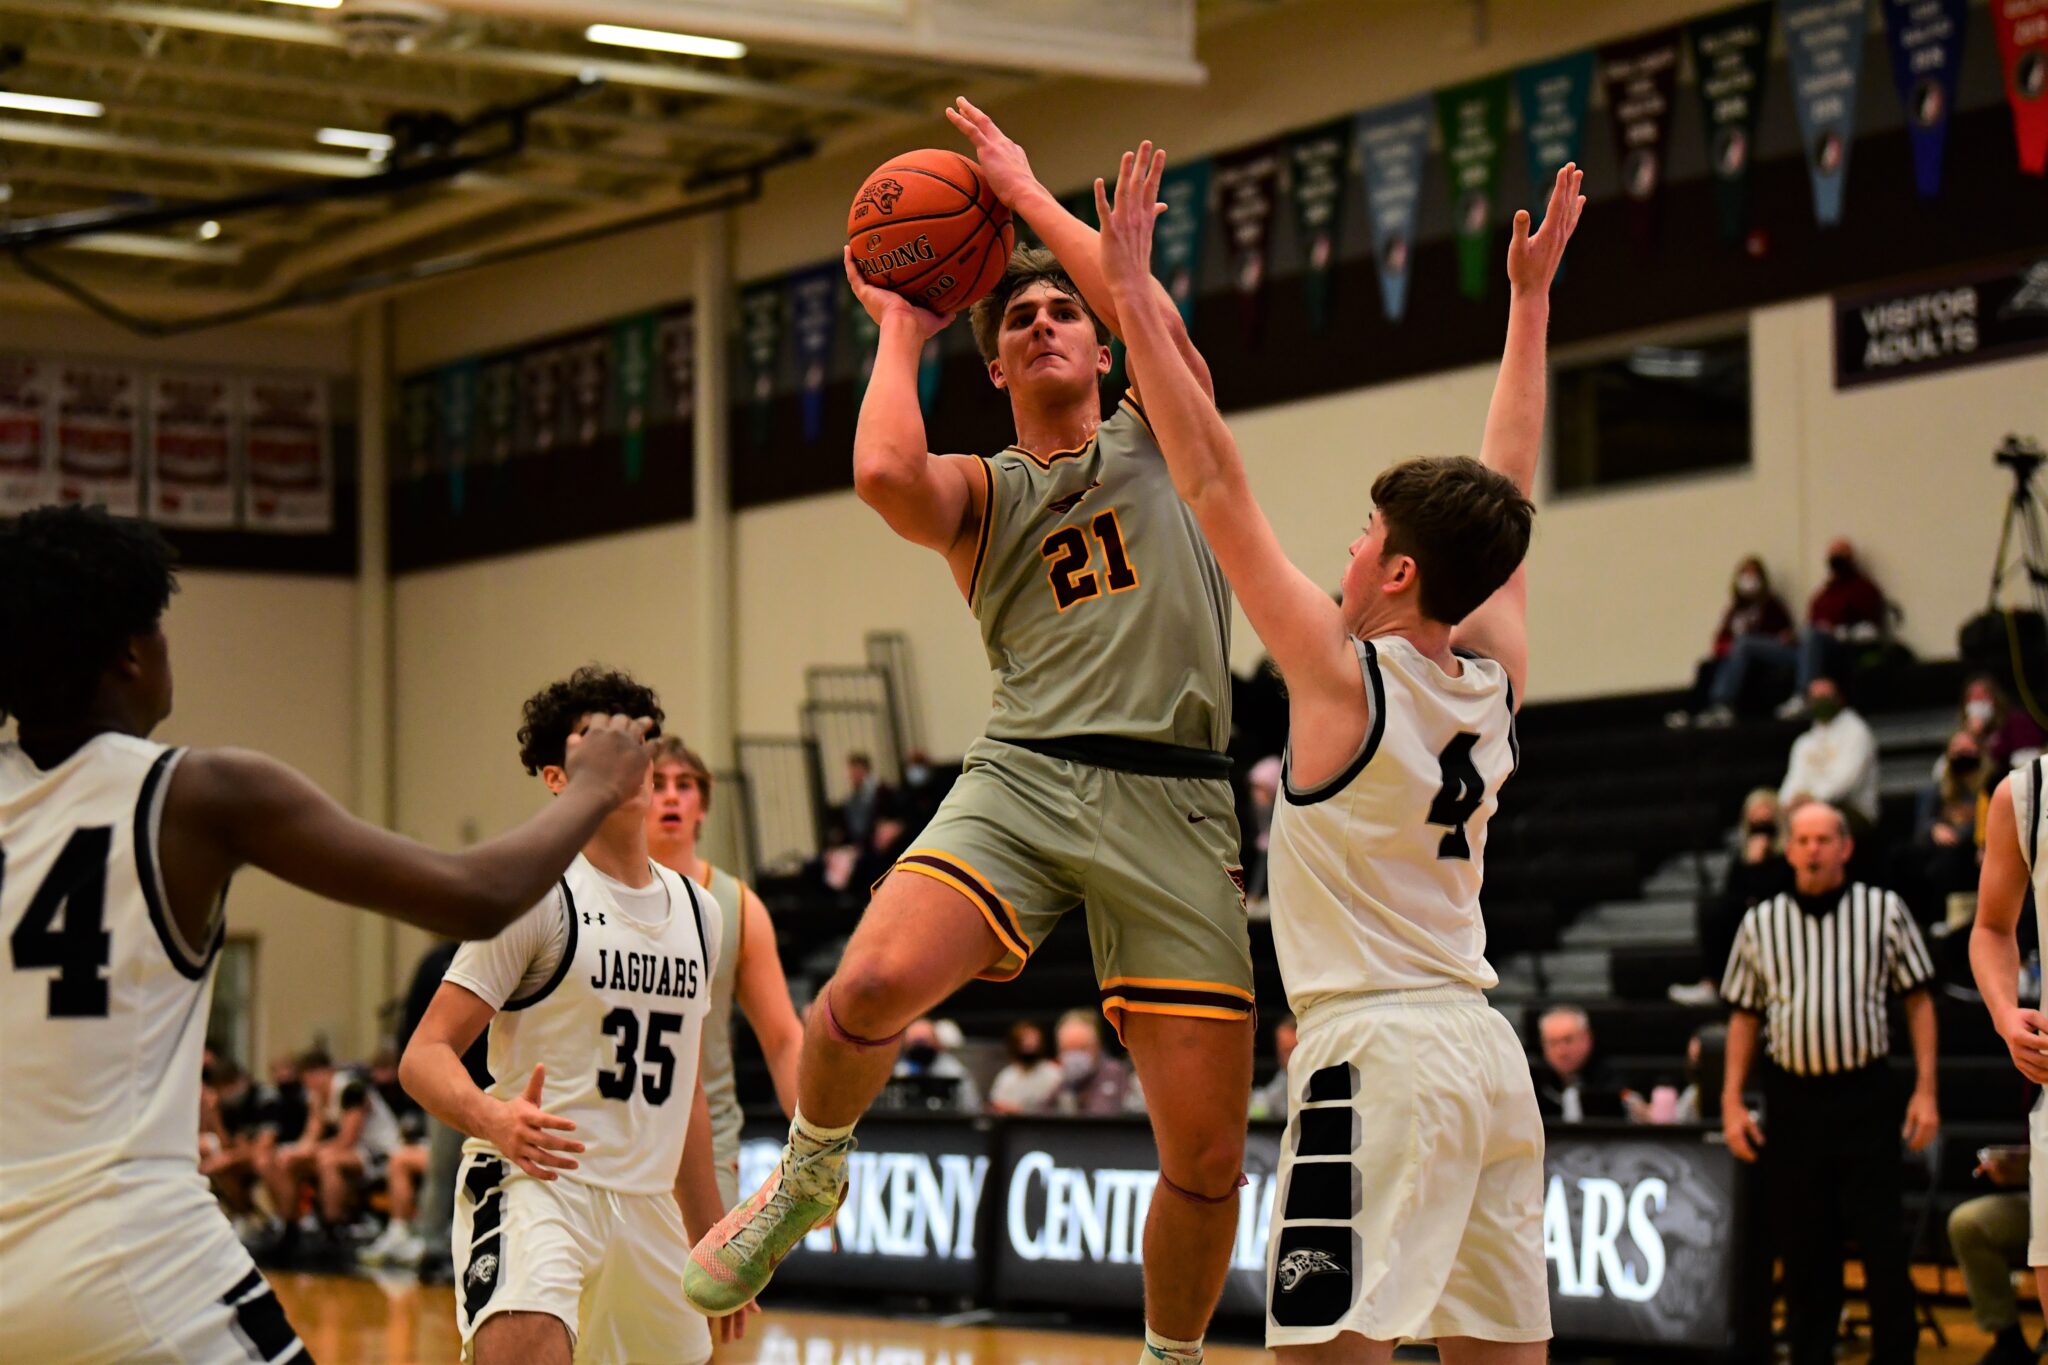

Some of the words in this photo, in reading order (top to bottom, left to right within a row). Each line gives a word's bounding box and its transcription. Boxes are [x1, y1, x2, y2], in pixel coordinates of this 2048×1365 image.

[857, 233, 935, 275] PALDING
[1861, 287, 1978, 336] VISITOR
[1863, 319, 1978, 370] ADULTS
[1040, 508, 1140, 614] 21
[1425, 730, 1486, 861] 4
[0, 823, 116, 1020] 4
[591, 949, 698, 999] JAGUARS
[597, 1006, 683, 1107] 35
[804, 1152, 990, 1260] NKENY
